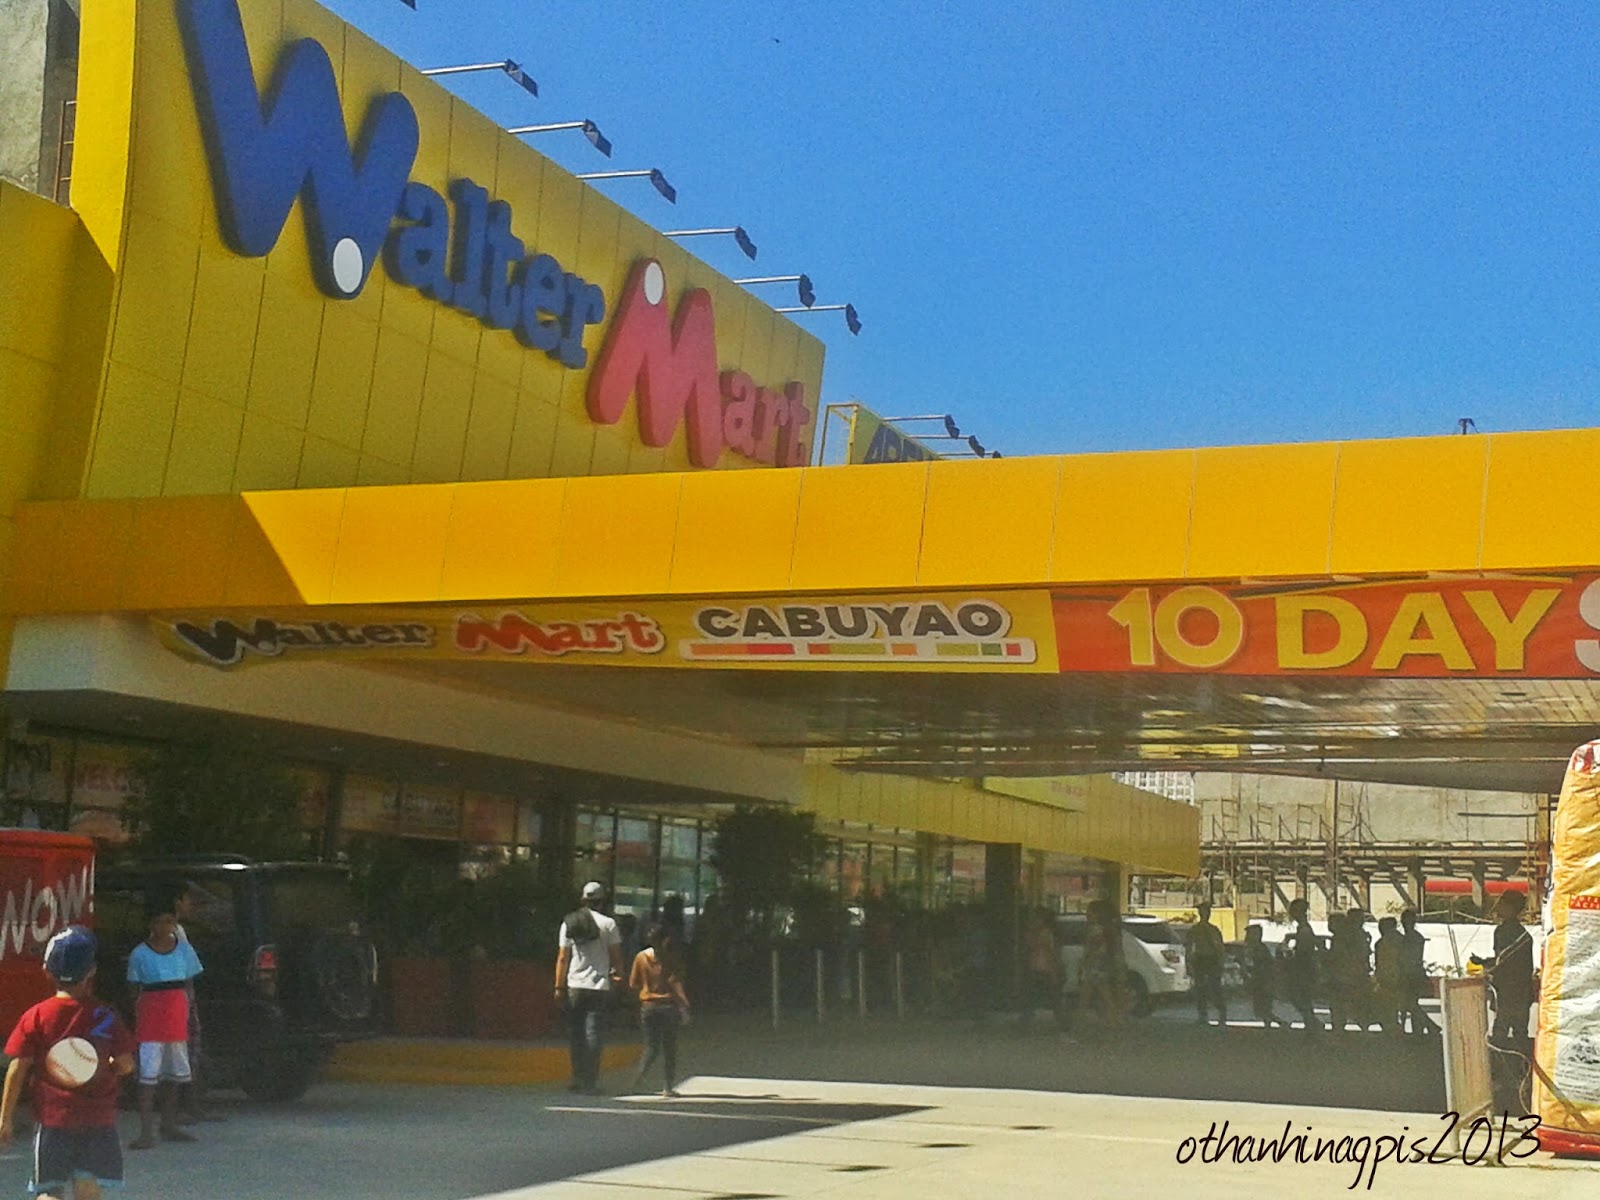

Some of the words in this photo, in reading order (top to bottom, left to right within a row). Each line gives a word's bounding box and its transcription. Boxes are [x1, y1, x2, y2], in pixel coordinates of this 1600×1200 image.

[172, 0, 606, 370] Walter
[588, 258, 813, 469] Mart
[174, 618, 430, 664] Walter
[455, 612, 661, 653] Mart
[698, 603, 1006, 639] CABUYAO
[1107, 585, 1244, 668] 10
